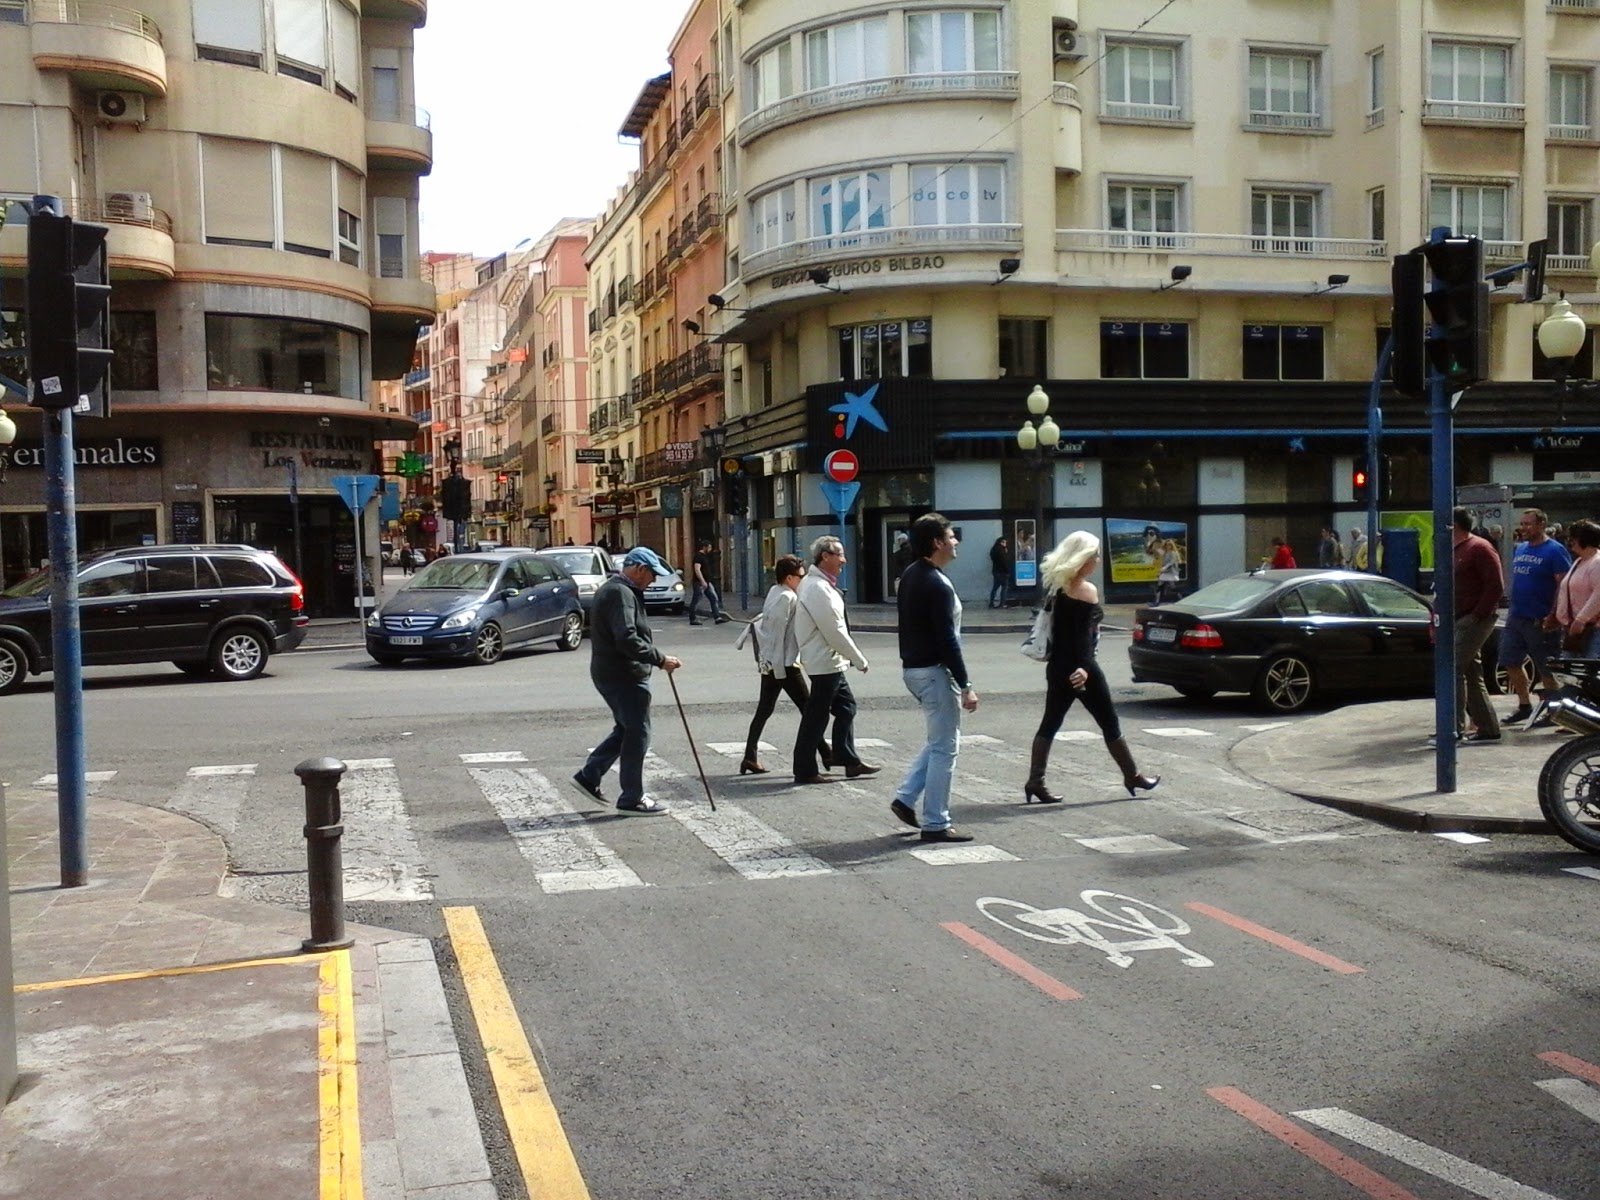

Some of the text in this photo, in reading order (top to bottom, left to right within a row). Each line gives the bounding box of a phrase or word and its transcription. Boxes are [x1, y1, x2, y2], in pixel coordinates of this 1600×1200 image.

[983, 189, 997, 200] tv
[826, 261, 881, 277] EGUROS
[889, 255, 945, 272] BILBAO
[672, 442, 692, 450] VENDE
[262, 450, 292, 469] Los
